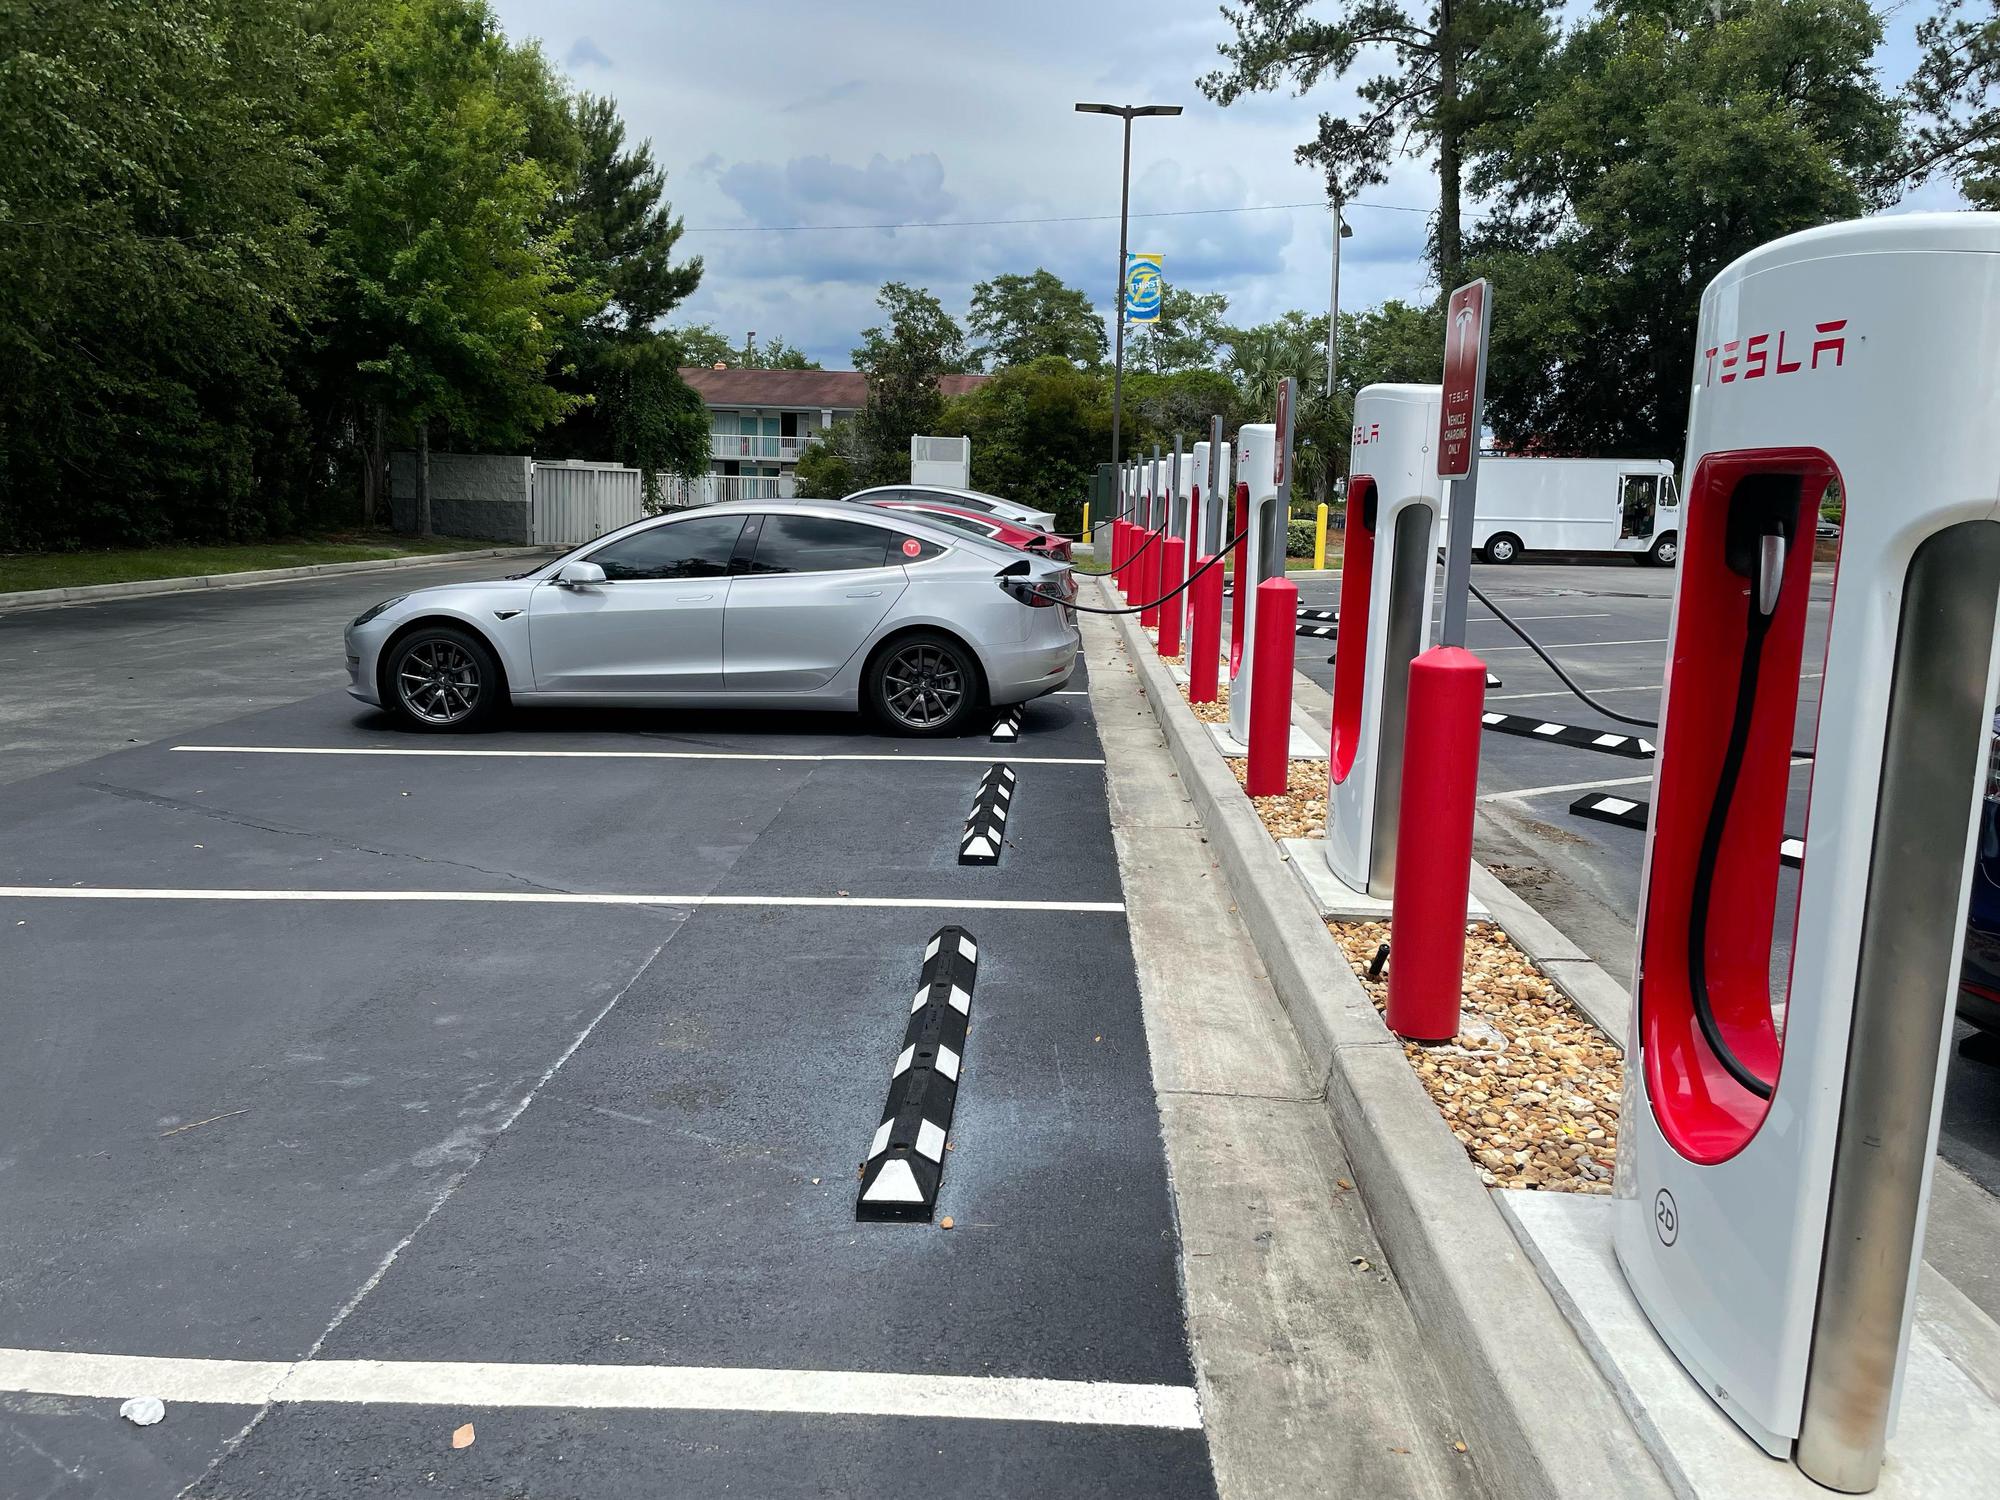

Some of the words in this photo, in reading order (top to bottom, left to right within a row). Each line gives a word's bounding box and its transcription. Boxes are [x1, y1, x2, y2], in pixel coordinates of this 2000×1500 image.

[1705, 320, 1847, 387] TESLA
[1449, 389, 1469, 403] TESLA
[1447, 410, 1466, 426] VEHICLE
[1353, 424, 1379, 445] ESLA
[1444, 427, 1467, 441] CHARGING
[1447, 443, 1461, 455] ONLY
[1658, 1201, 1674, 1231] 2D
